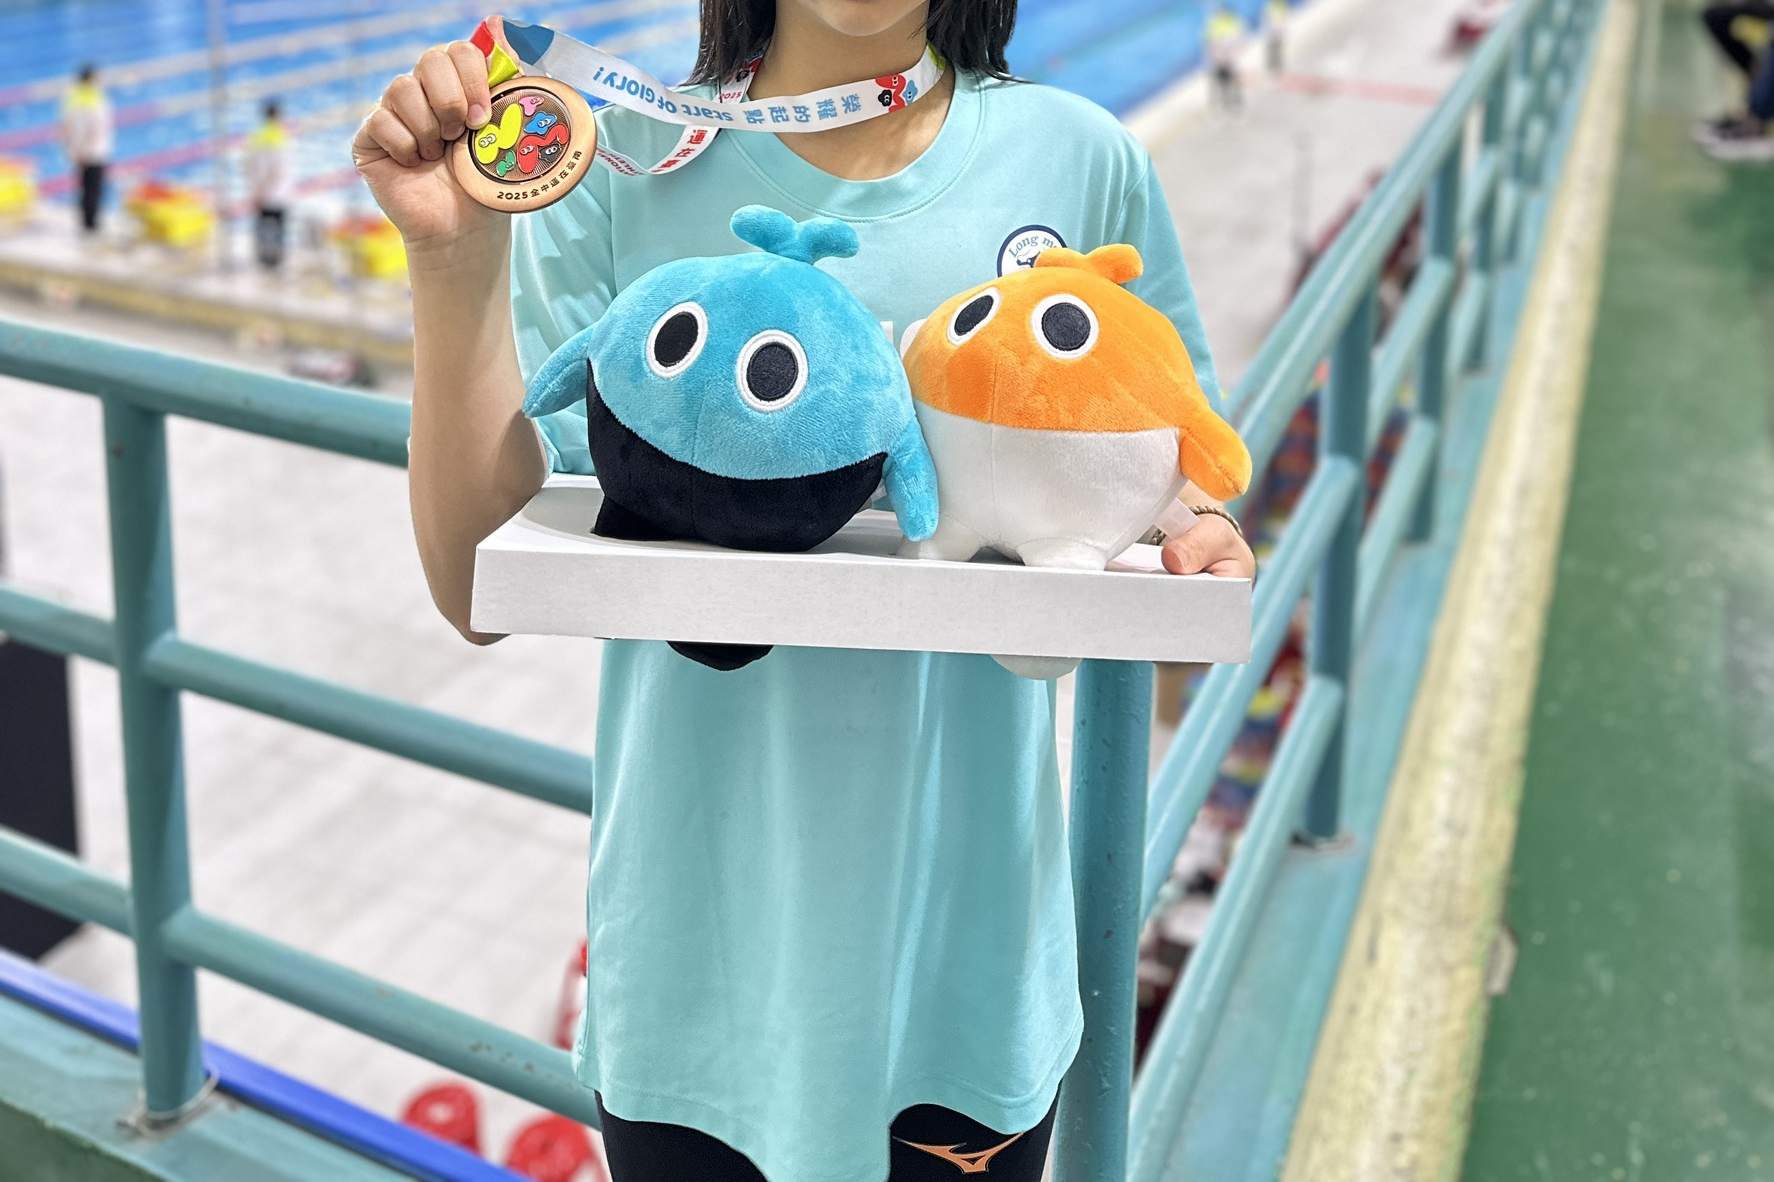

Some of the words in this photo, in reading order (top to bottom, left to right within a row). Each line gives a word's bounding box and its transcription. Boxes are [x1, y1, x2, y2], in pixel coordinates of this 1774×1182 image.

[742, 93, 862, 124] 榮耀的起點
[1008, 235, 1039, 259] Long
[1041, 237, 1058, 249] m
